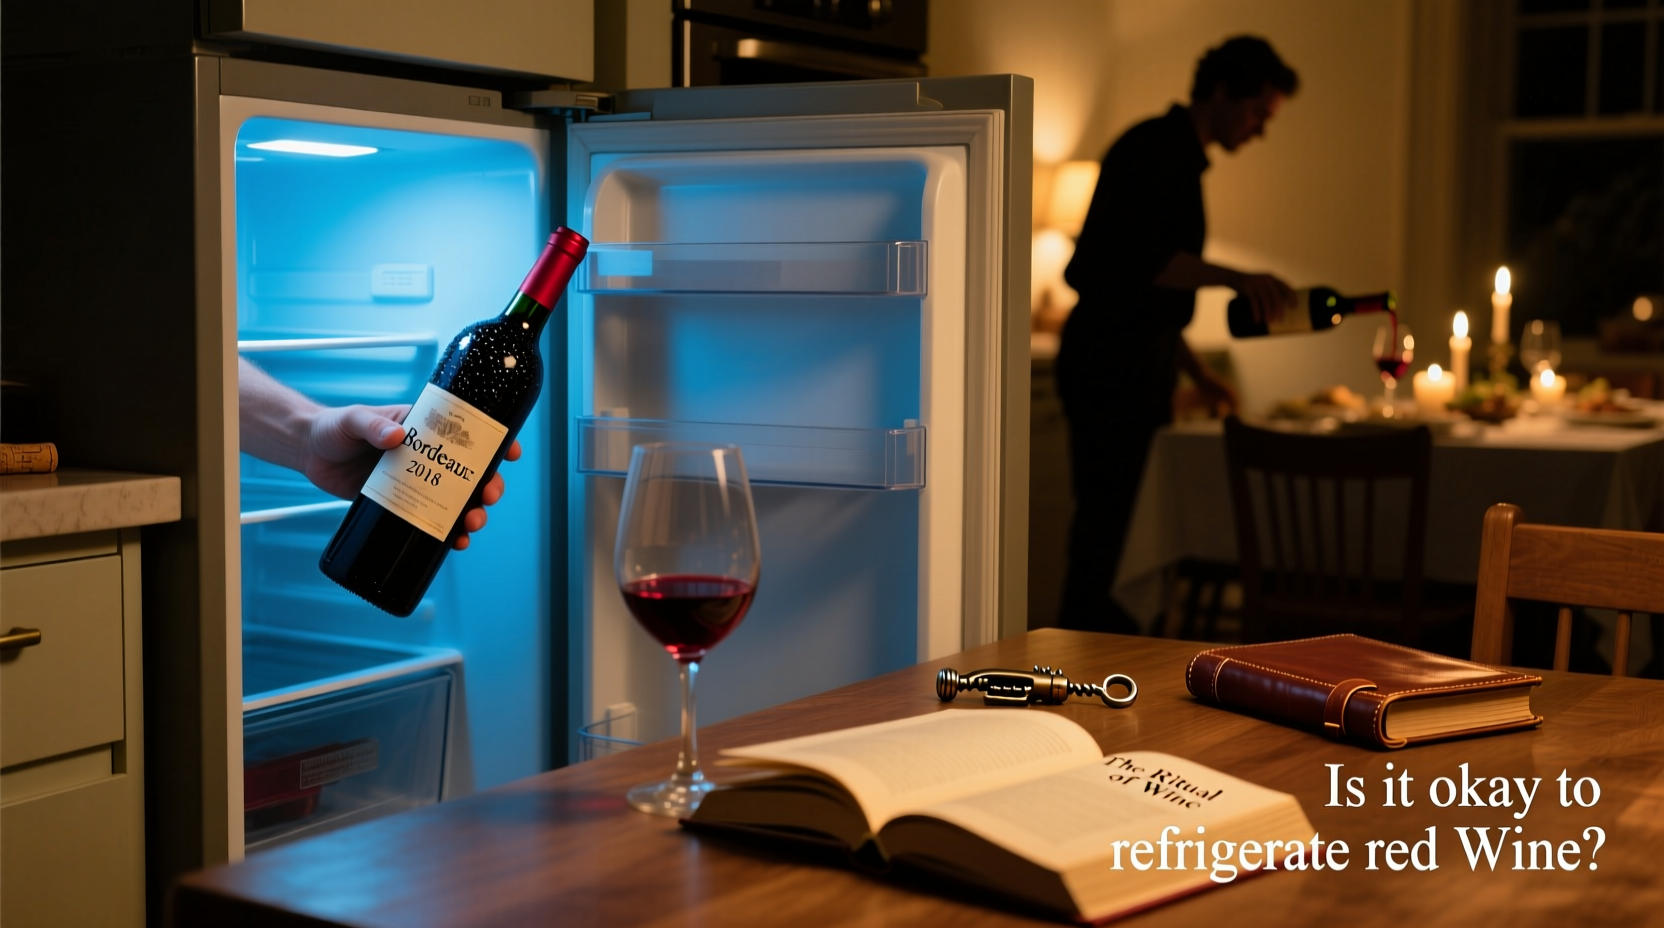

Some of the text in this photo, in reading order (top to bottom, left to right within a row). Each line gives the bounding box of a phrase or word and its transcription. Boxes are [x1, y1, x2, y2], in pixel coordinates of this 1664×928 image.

[405, 460, 442, 487] 2018
[1109, 775, 1140, 785] of
[1150, 769, 1223, 801] Ritual
